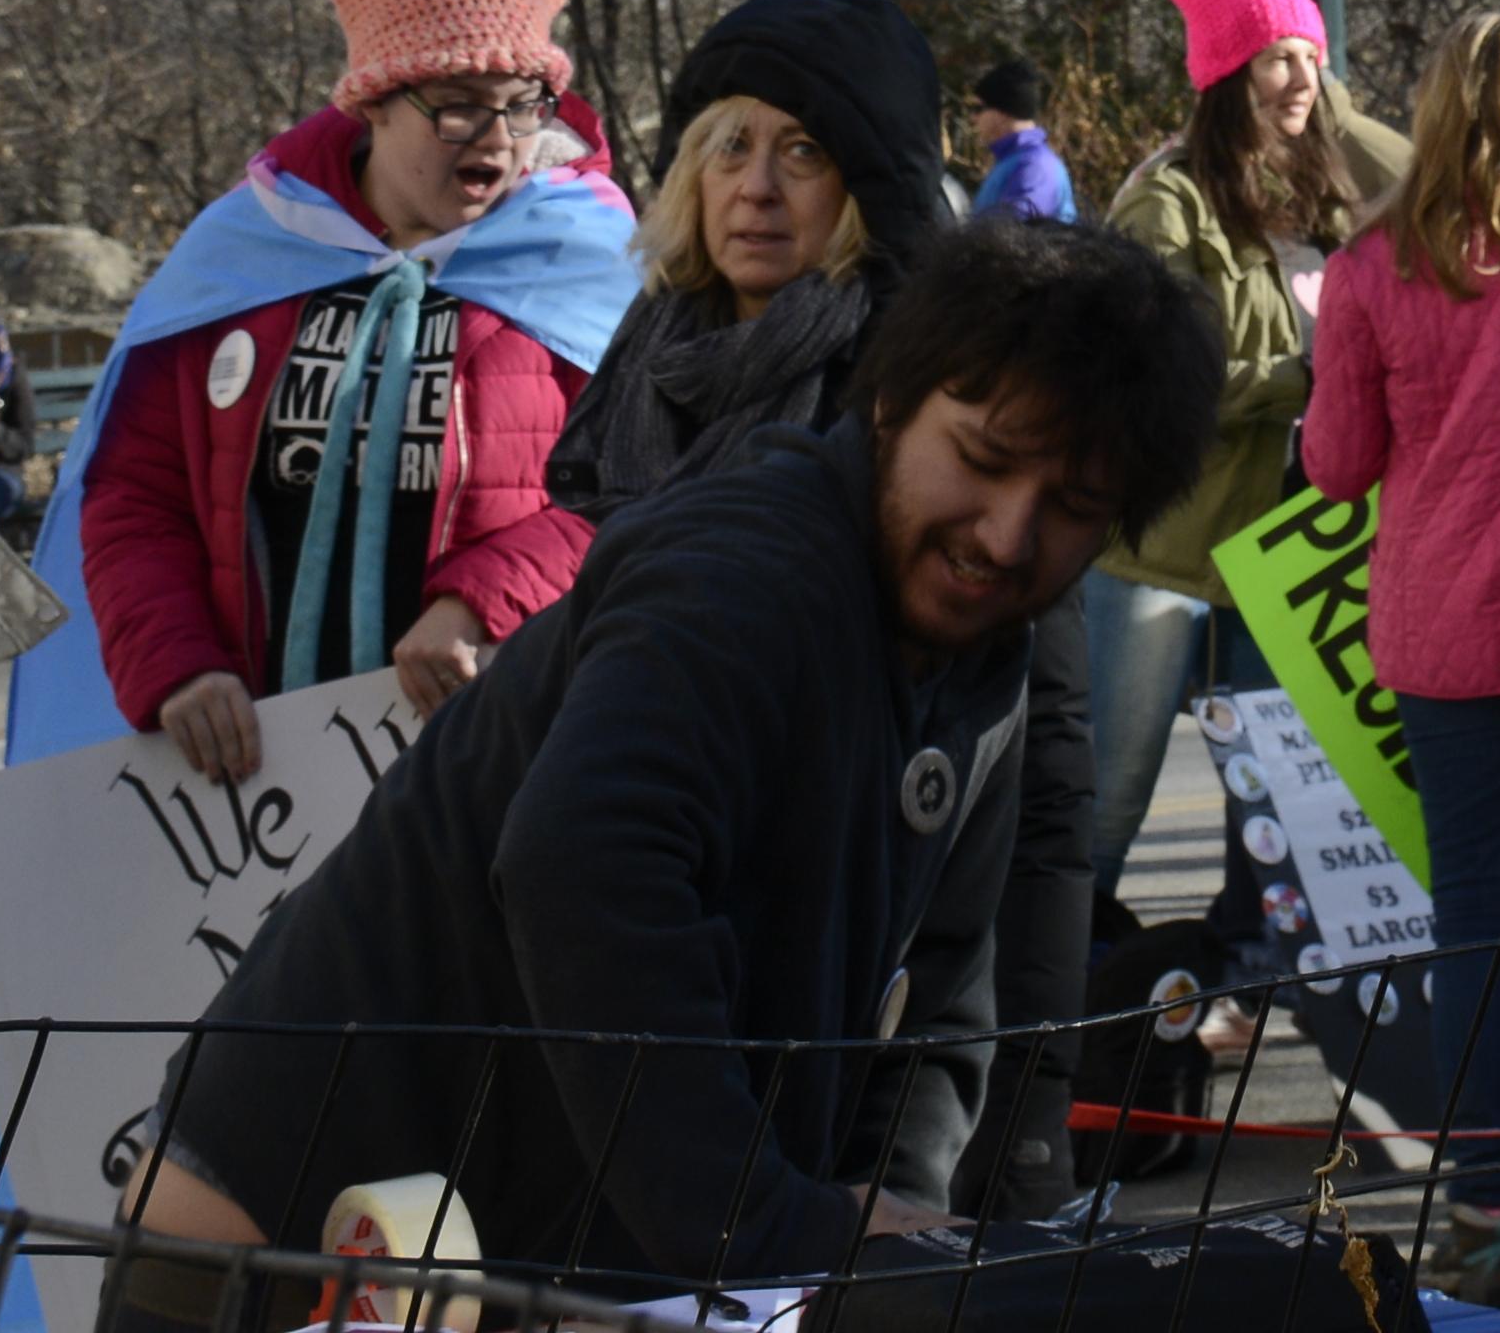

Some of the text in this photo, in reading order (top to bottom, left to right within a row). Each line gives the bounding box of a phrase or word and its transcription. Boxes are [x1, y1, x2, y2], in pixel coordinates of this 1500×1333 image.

[108, 761, 311, 900] We
[1319, 840, 1399, 871] SMAL
[1366, 884, 1399, 908] $3
